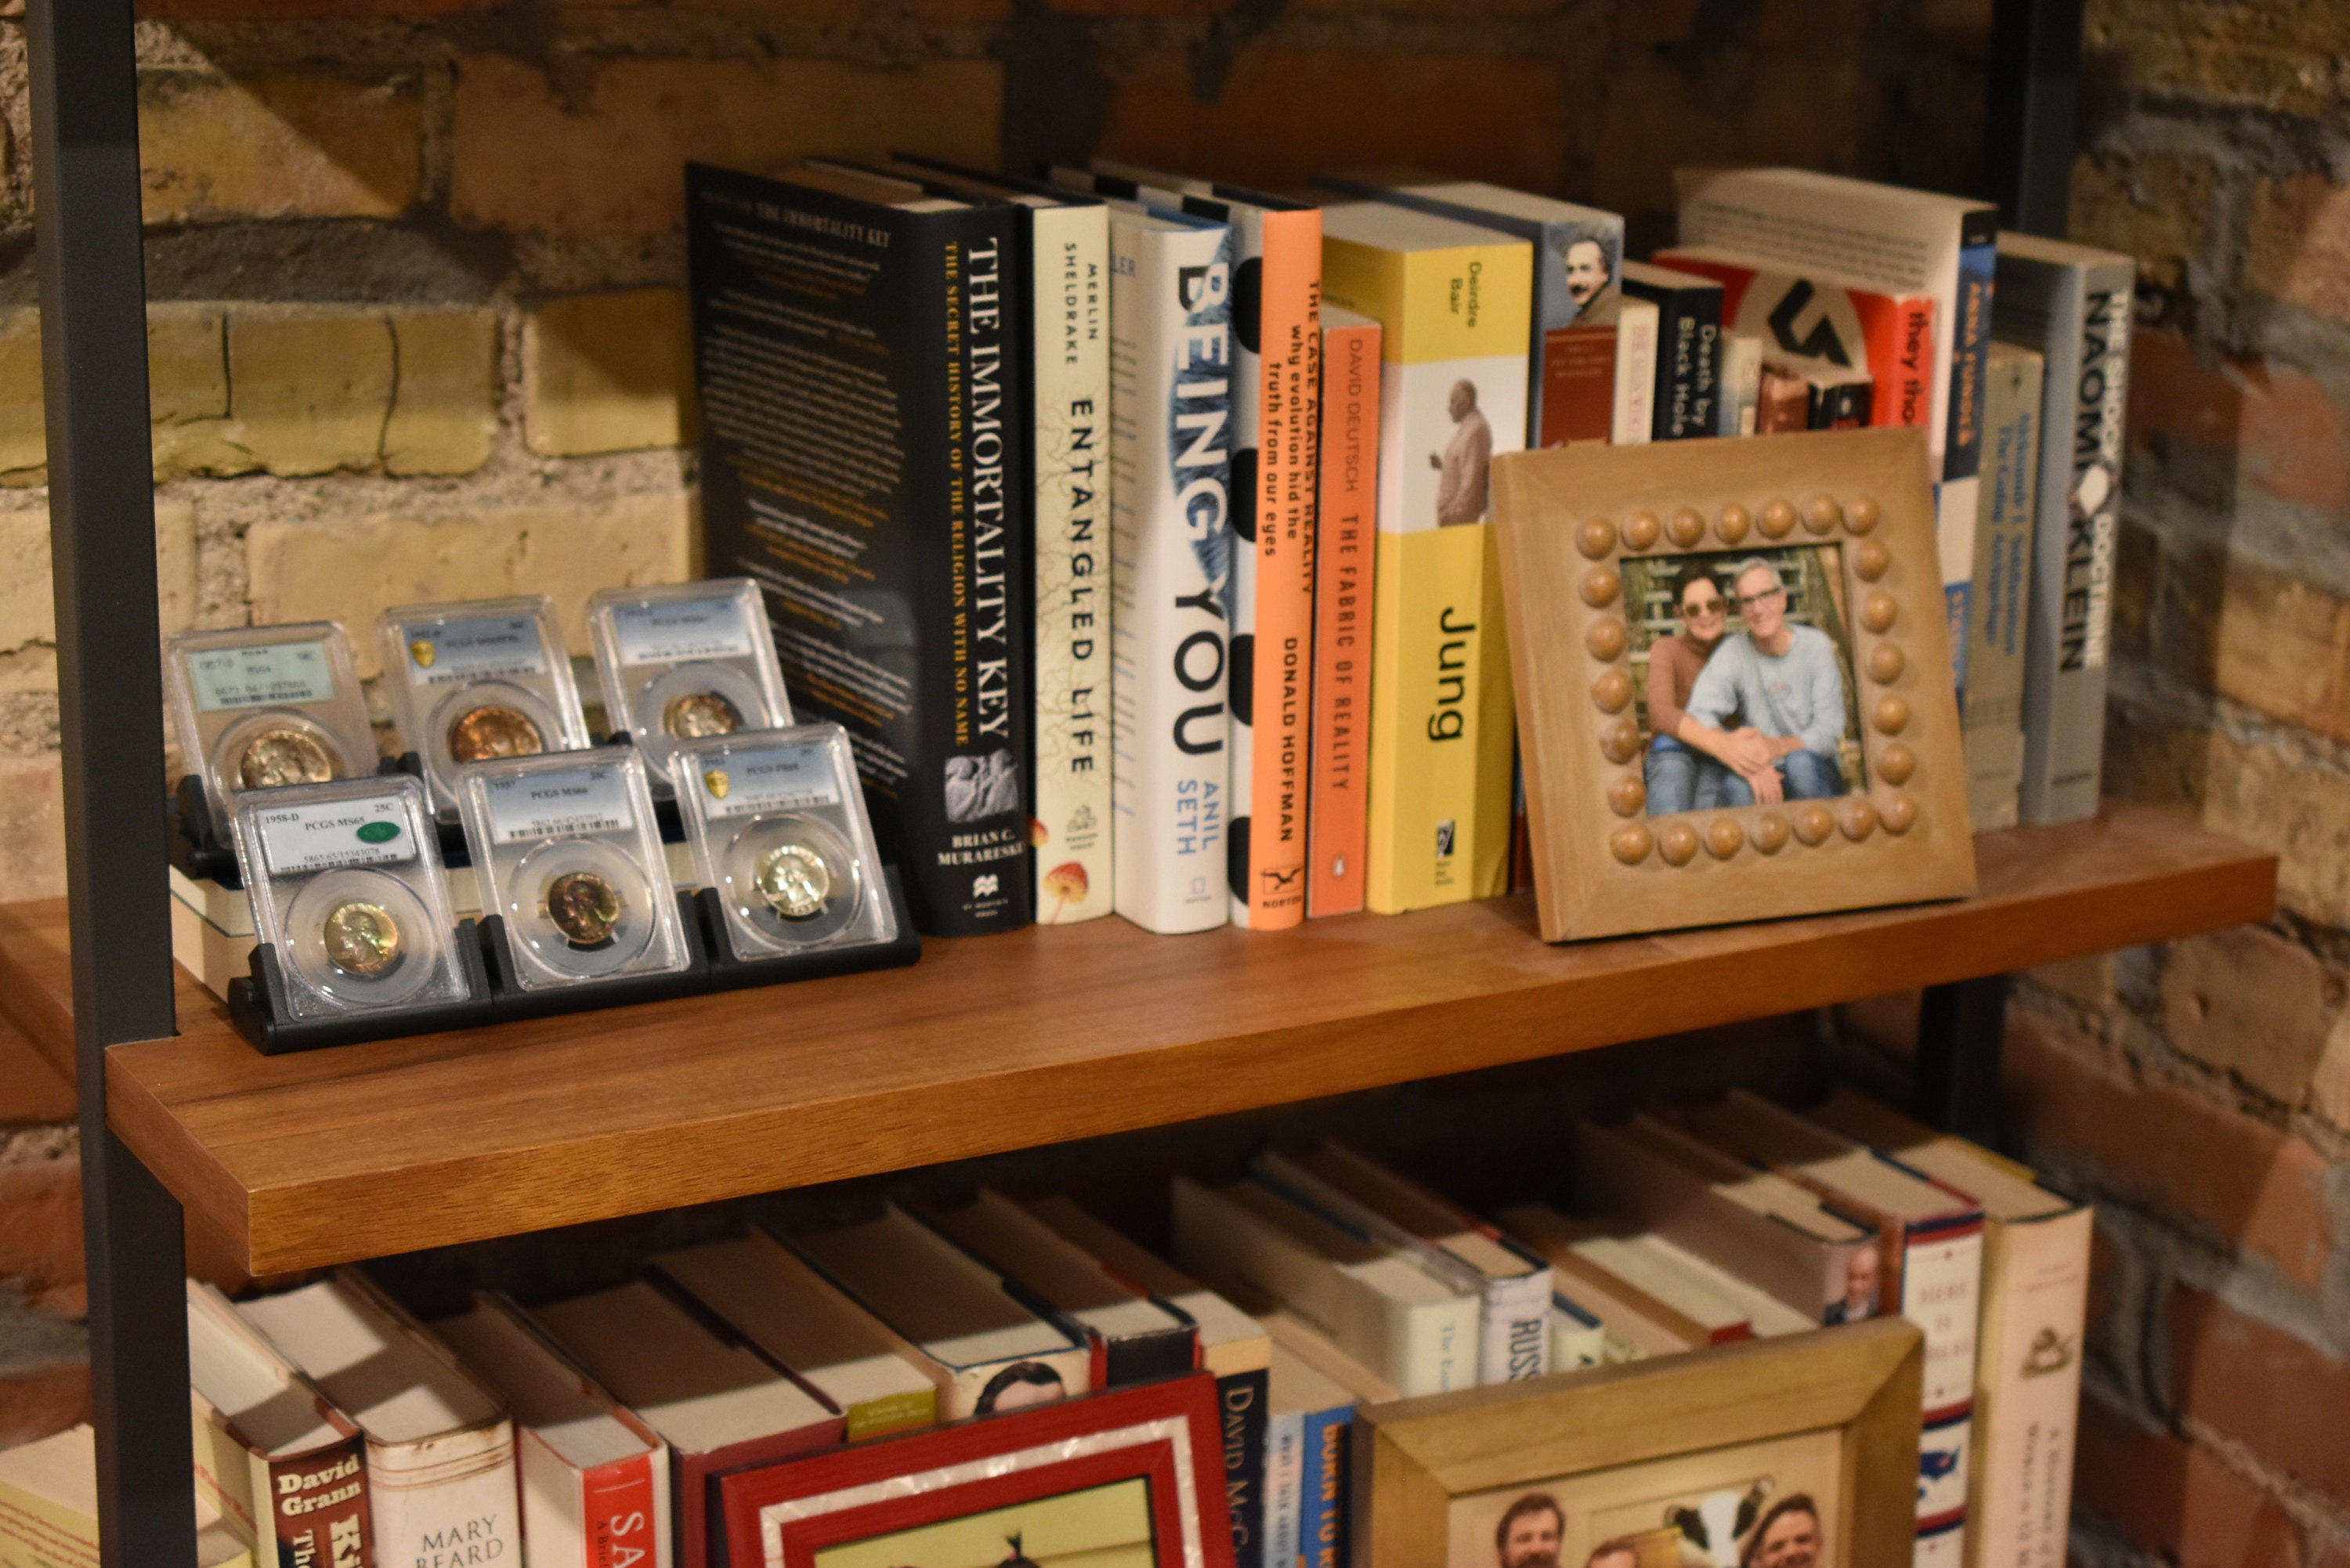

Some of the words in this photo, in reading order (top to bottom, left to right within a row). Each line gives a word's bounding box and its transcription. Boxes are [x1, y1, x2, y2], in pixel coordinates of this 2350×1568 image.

[945, 241, 960, 280] THE
[969, 237, 1000, 334] THE
[946, 285, 961, 356] SECRET
[1065, 242, 1078, 365] SHELDRAKE
[1087, 263, 1098, 340] MERLIN
[1310, 280, 1321, 321] THE
[1450, 277, 1464, 315] Bair
[1467, 261, 1482, 329] Deirdre
[1289, 325, 1302, 366] why
[1307, 331, 1320, 388] CASE
[1347, 338, 1363, 396] DAVID
[1676, 316, 1695, 378] Black
[1697, 323, 1717, 393] Death
[1900, 311, 1929, 370] they
[947, 360, 964, 442] HISTORY
[1175, 262, 1231, 542] BEING
[1267, 362, 1282, 414] truth
[1672, 383, 1690, 436] Hole
[1902, 379, 1925, 427] tho
[2074, 289, 2113, 475] NAOMI
[1289, 372, 1303, 465] evolution
[1691, 398, 1712, 427] by
[949, 447, 964, 471] OF
[1266, 420, 1280, 466] from
[1304, 398, 1318, 493] AGAINST
[1345, 400, 1361, 493] DEUTSCH
[950, 477, 965, 515] THE
[971, 344, 1006, 644] IMMORTALITY
[1266, 472, 1278, 504] our
[1289, 471, 1301, 502] hid
[1071, 399, 1094, 660] ENTANGLED
[1262, 511, 1277, 557] eyes
[1287, 508, 1300, 540] the
[1302, 502, 1315, 594] REALITY
[1340, 514, 1359, 555] THE
[951, 519, 967, 608] RELIGION
[1336, 565, 1358, 648] FABRIC
[2059, 517, 2095, 674] KLEIN
[953, 612, 968, 663] WITH
[1173, 574, 1225, 756] YOU
[955, 667, 969, 692] NO
[977, 658, 1009, 739] KEY
[1282, 637, 1299, 727] DONALD
[1335, 660, 1354, 685] OF
[1427, 607, 1477, 742] Jung
[956, 696, 971, 746] NAME
[1072, 688, 1094, 773] LIFE
[1332, 695, 1352, 790] REALITY
[1176, 779, 1198, 855] SETH
[1202, 780, 1220, 851] ANIL
[1280, 735, 1297, 843] HOFFMAN
[265, 812, 300, 826] 1958-D
[304, 819, 336, 832] PCGS
[337, 815, 367, 829] MS65
[951, 832, 1000, 849] BRIAN
[1000, 828, 1016, 842] C.
[277, 1453, 361, 1495] David
[280, 1480, 363, 1518] Grann
[292, 1528, 316, 1568] Th
[421, 1513, 498, 1554] MARY
